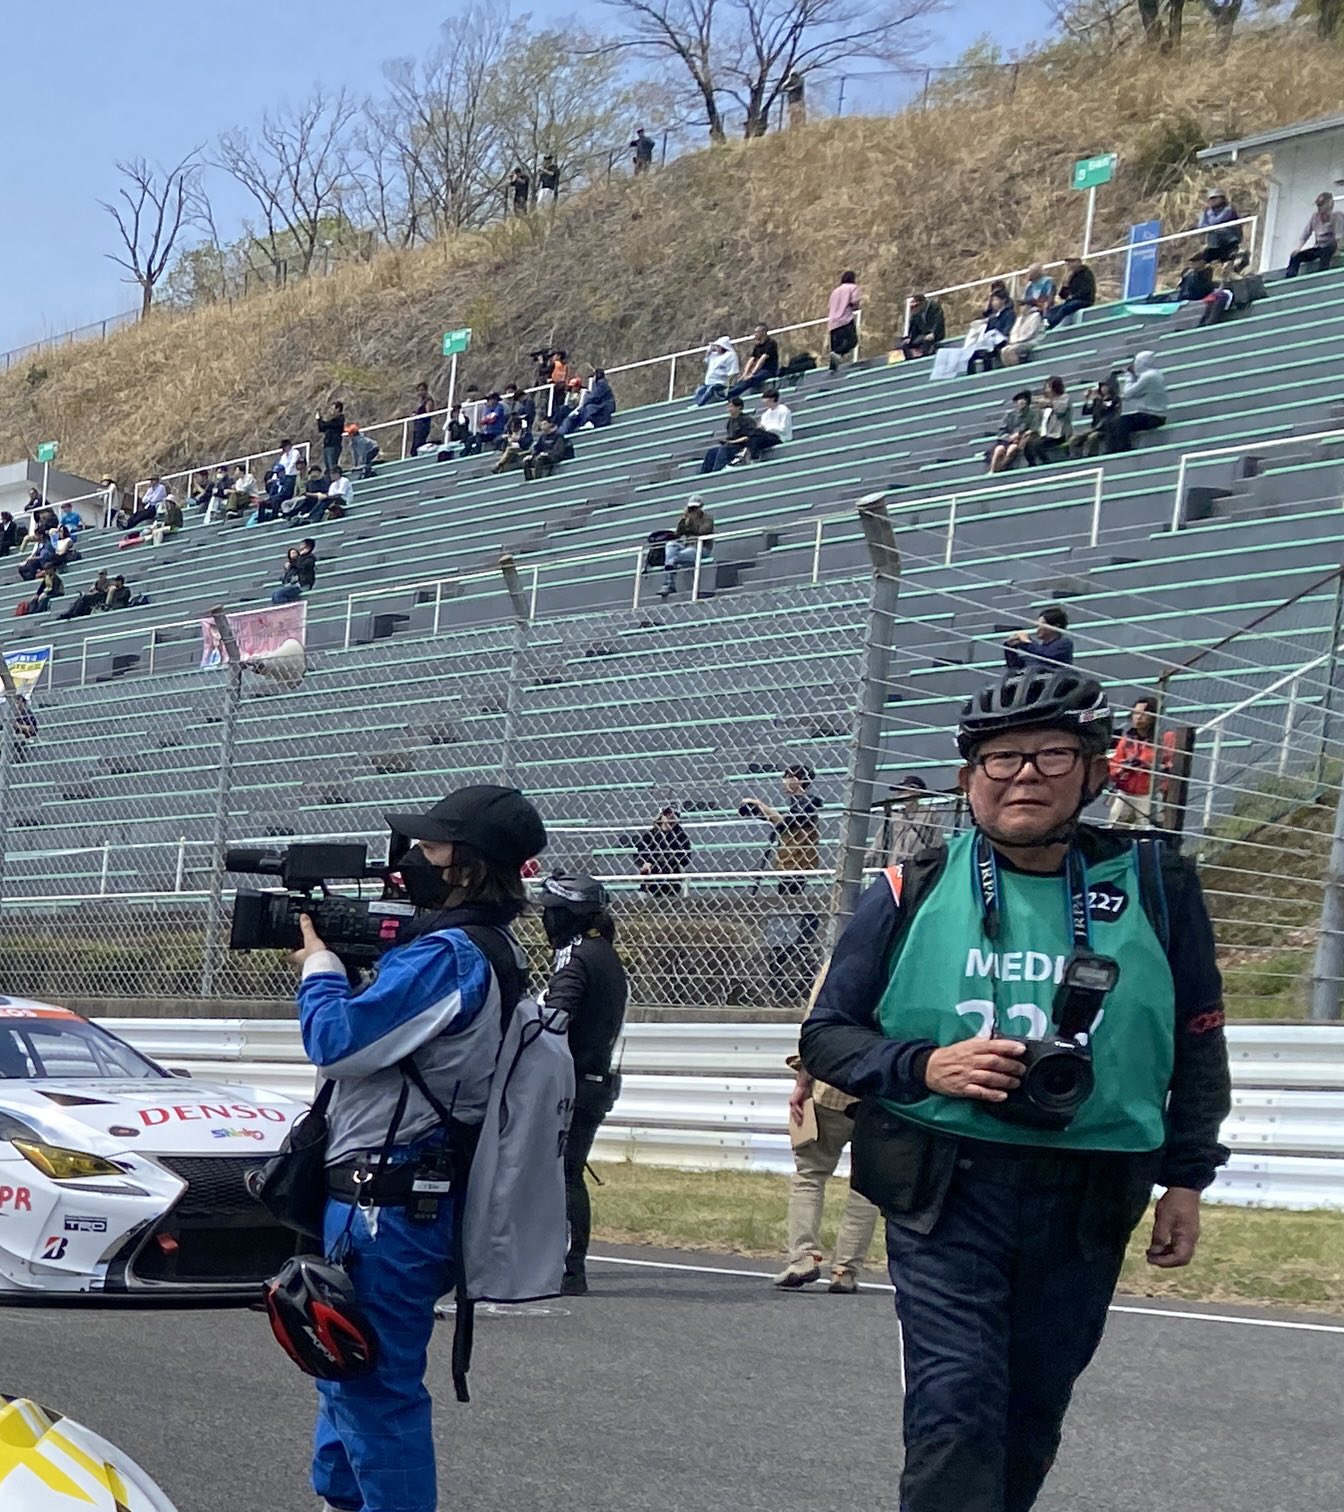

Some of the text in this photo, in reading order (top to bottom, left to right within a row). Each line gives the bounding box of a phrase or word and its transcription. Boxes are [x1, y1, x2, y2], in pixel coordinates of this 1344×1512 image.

[1088, 890, 1125, 913] 227
[965, 947, 1066, 986] MEDI
[138, 1104, 287, 1128] DENSO
